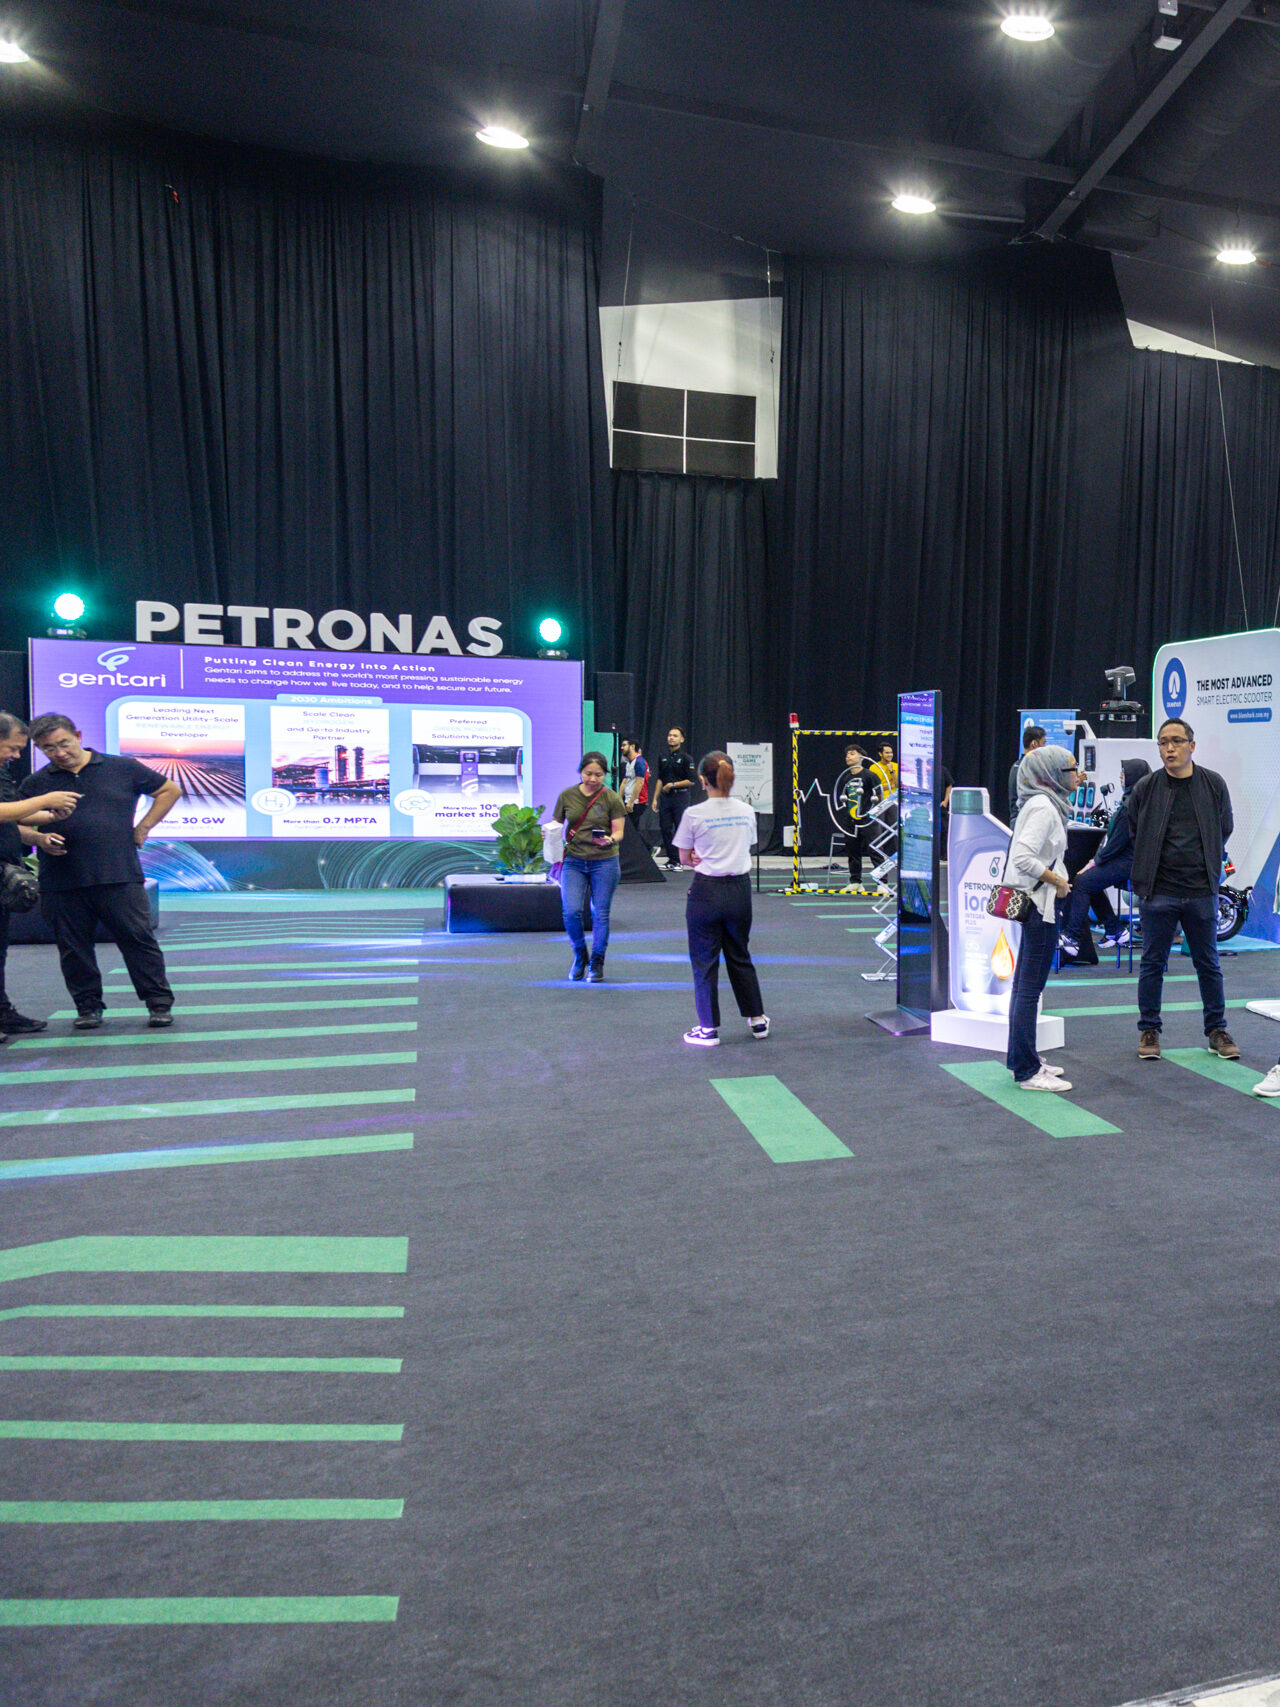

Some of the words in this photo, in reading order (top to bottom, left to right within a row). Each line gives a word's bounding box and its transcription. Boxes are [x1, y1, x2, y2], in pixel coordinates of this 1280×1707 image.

[135, 600, 504, 656] PETRONAS
[204, 656, 257, 666] Putting
[262, 659, 303, 667] Clean
[308, 661, 356, 670] Energy
[392, 664, 435, 672] Action
[58, 672, 166, 688] gentari
[204, 666, 243, 674] Gentari
[282, 669, 321, 677] address
[341, 671, 374, 679] world's
[400, 674, 438, 682] pressing
[440, 675, 492, 683] sustainable
[493, 678, 523, 686] energy
[204, 676, 236, 684] needs
[250, 678, 289, 687] change
[290, 679, 311, 687] how
[331, 680, 348, 688] live
[1197, 680, 1209, 691] THE
[1210, 678, 1230, 690] MOST
[1231, 674, 1273, 689] ADVANCED
[1197, 695, 1214, 706] SMART
[1216, 693, 1243, 705] ELECTRIC
[1244, 691, 1273, 703] SCOOTER
[181, 817, 199, 825] 30
[201, 817, 226, 825] GW
